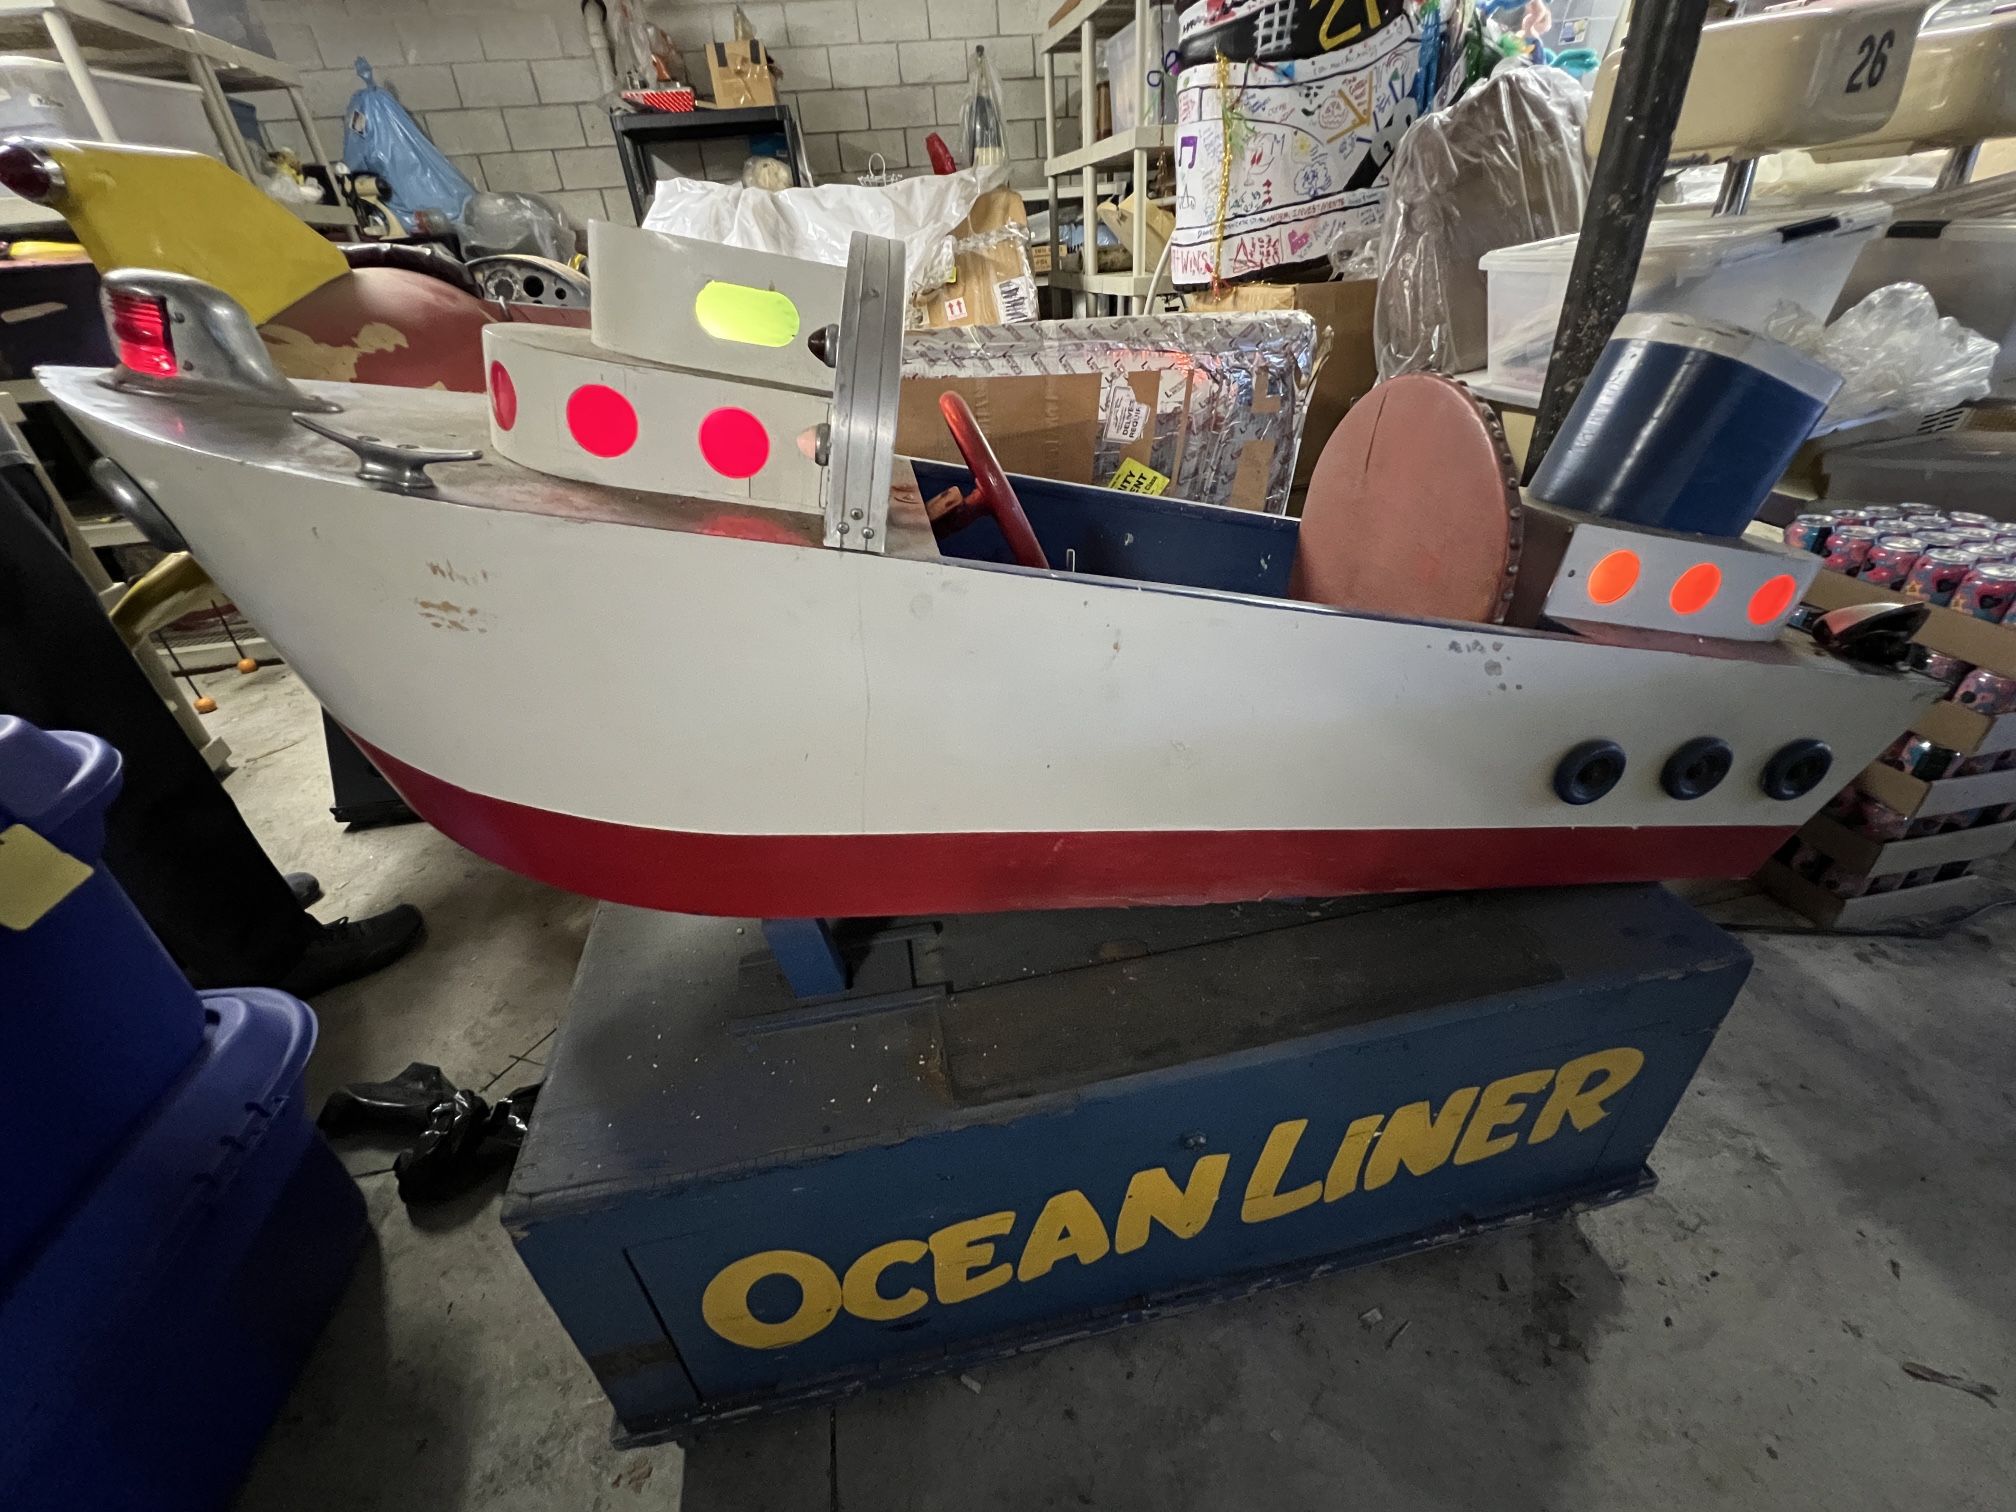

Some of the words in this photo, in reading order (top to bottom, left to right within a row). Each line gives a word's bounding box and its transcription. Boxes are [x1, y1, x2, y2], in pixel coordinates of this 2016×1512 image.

[1844, 28, 1895, 94] 26
[1117, 470, 1136, 491] ITY
[701, 1153, 1233, 1349] OCEAN
[1241, 1046, 1645, 1225] LINER
